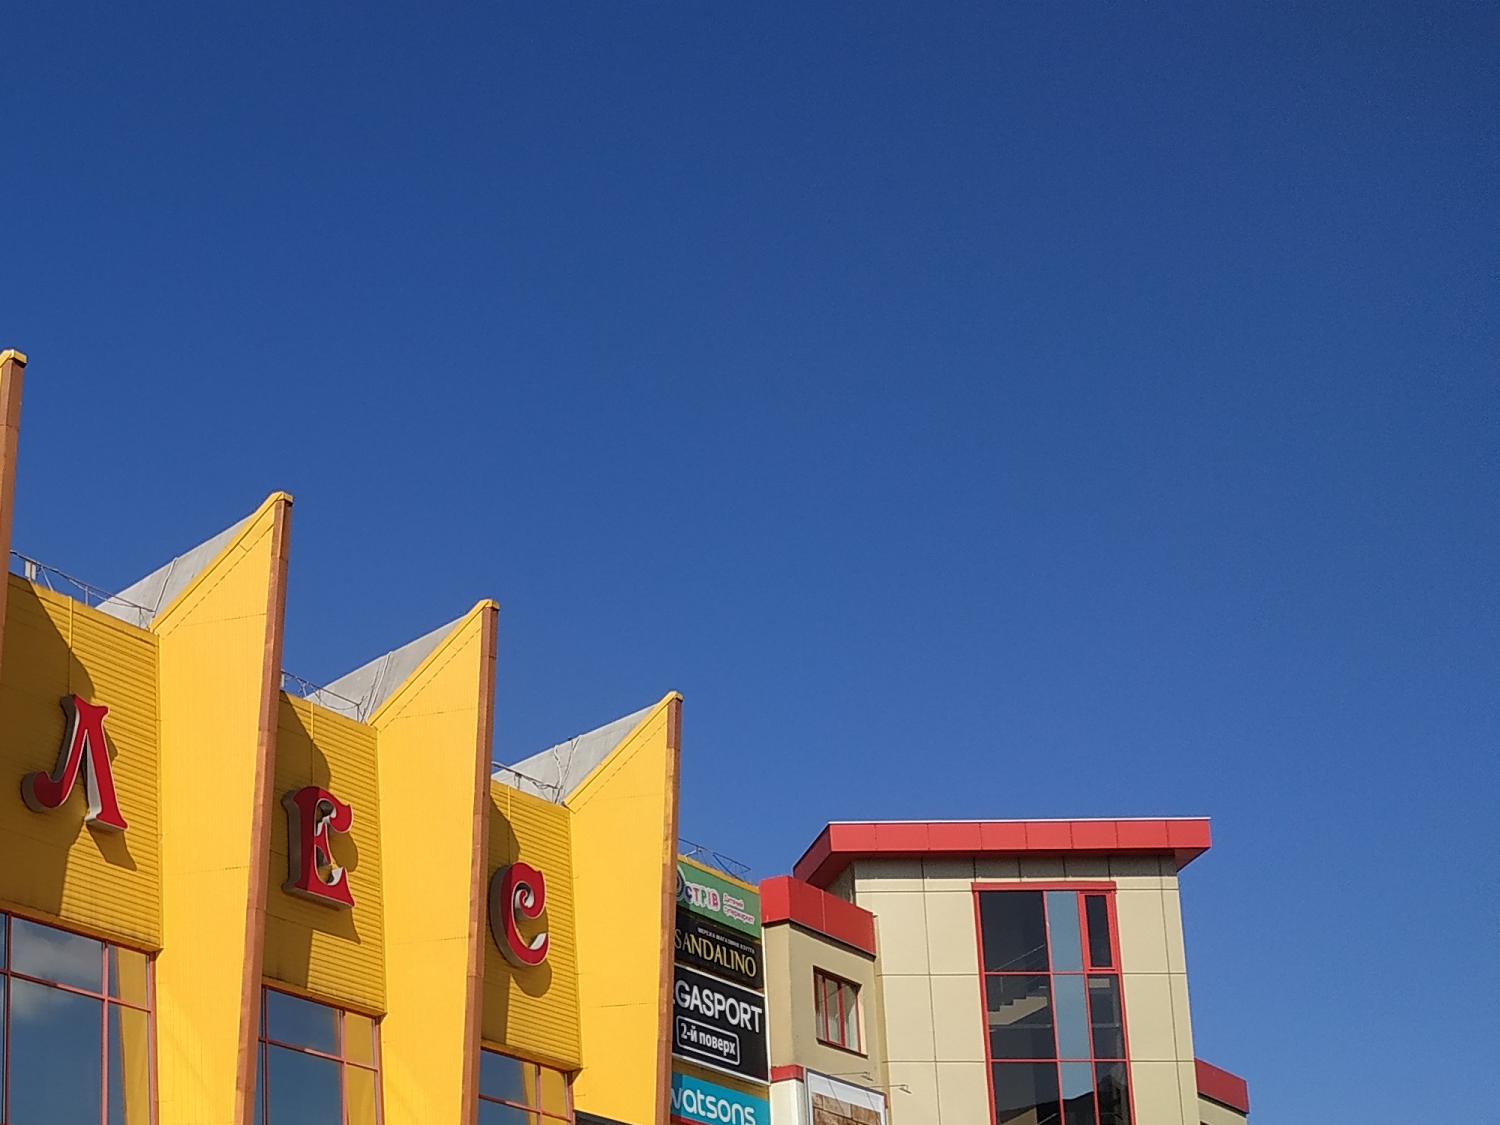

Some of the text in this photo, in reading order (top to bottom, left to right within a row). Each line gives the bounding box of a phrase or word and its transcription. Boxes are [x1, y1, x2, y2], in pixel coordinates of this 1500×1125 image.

[674, 928, 757, 977] SANDALINO
[673, 979, 763, 1034] GASPORT
[680, 1022, 736, 1056] 2-й поверх
